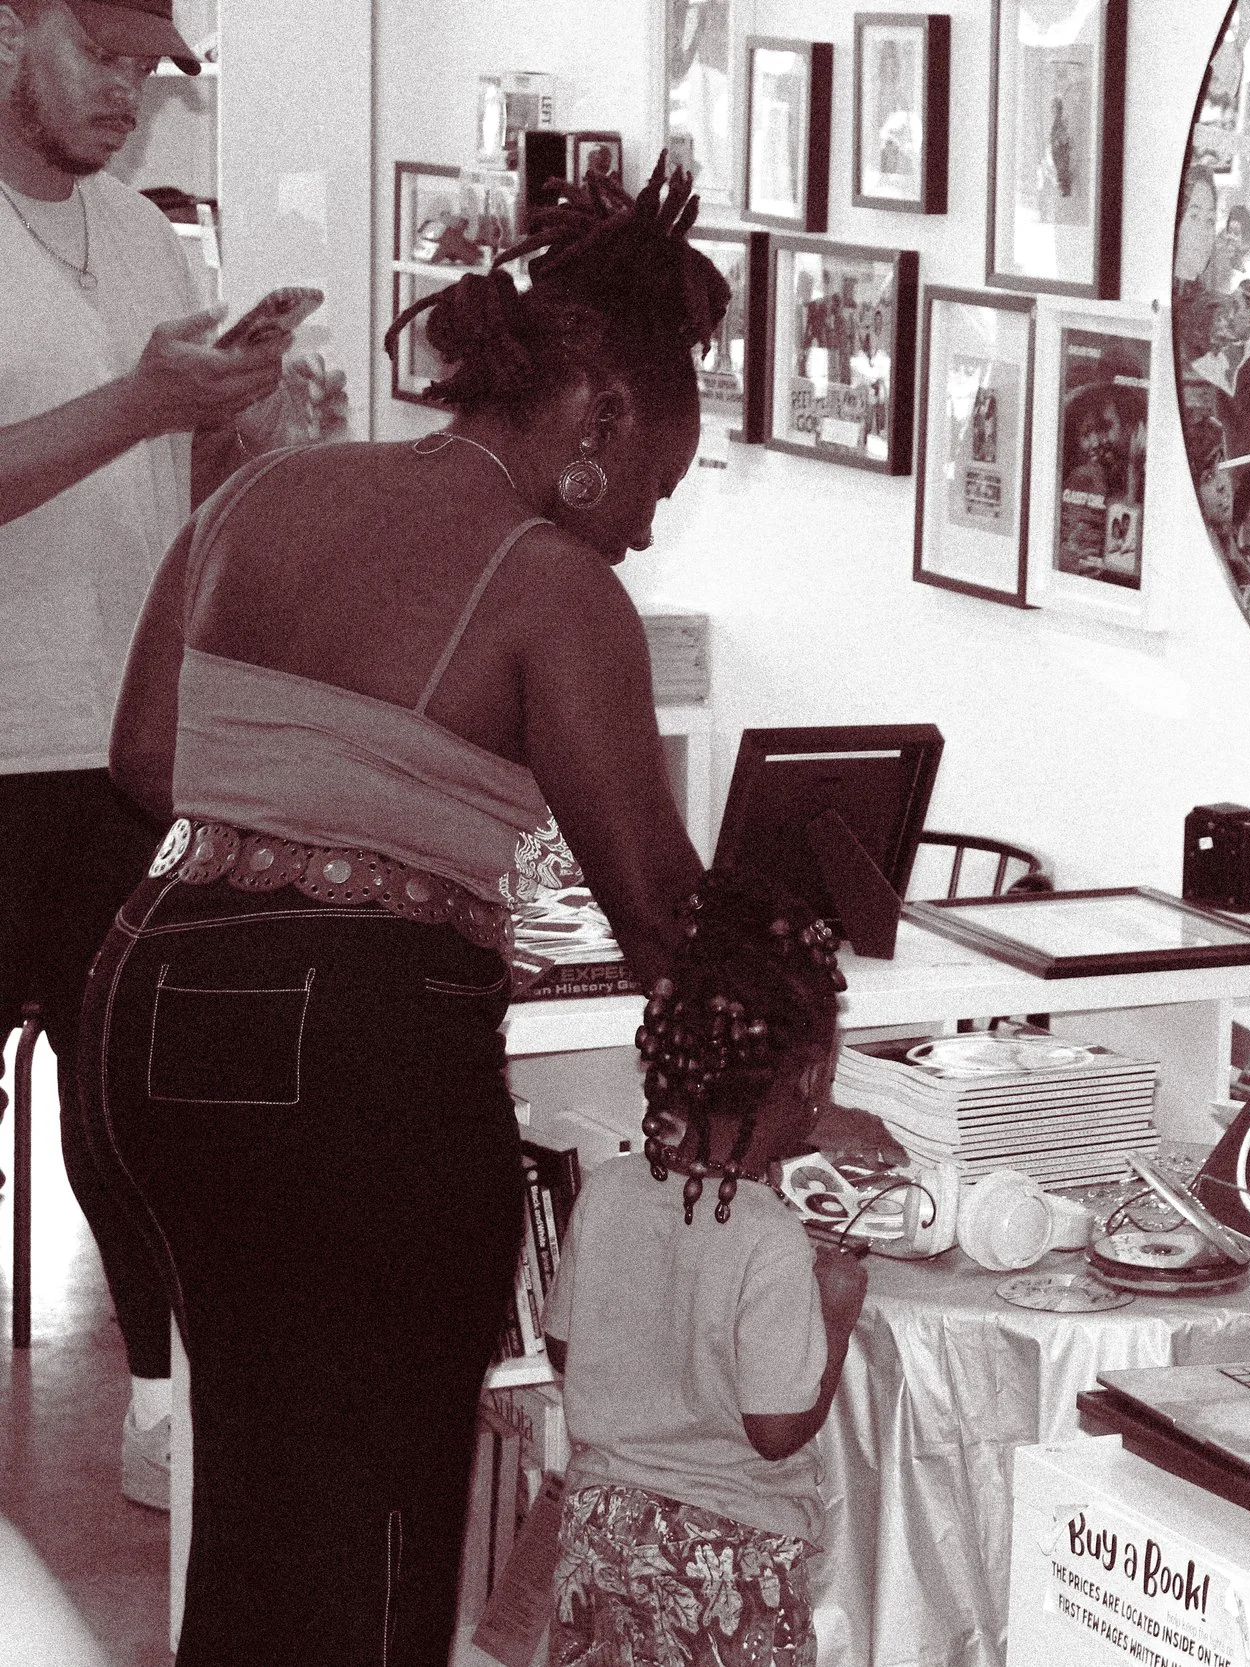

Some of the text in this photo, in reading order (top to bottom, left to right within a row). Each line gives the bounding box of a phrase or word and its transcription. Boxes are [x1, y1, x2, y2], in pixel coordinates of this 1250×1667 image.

[555, 982, 614, 994] History
[530, 1185, 541, 1208] Black
[536, 1224, 548, 1248] White
[1068, 1512, 1210, 1622] Buy a Book!
[1052, 1561, 1068, 1582] THE
[1069, 1571, 1101, 1602] PRICES
[1102, 1591, 1120, 1614] ARE
[1121, 1600, 1161, 1638] LOCATED
[1162, 1627, 1196, 1657] INSIDE
[1198, 1646, 1212, 1667] ON
[1058, 1594, 1081, 1622] FIRST
[1082, 1609, 1101, 1634] FEW
[1102, 1621, 1129, 1651] PAGES
